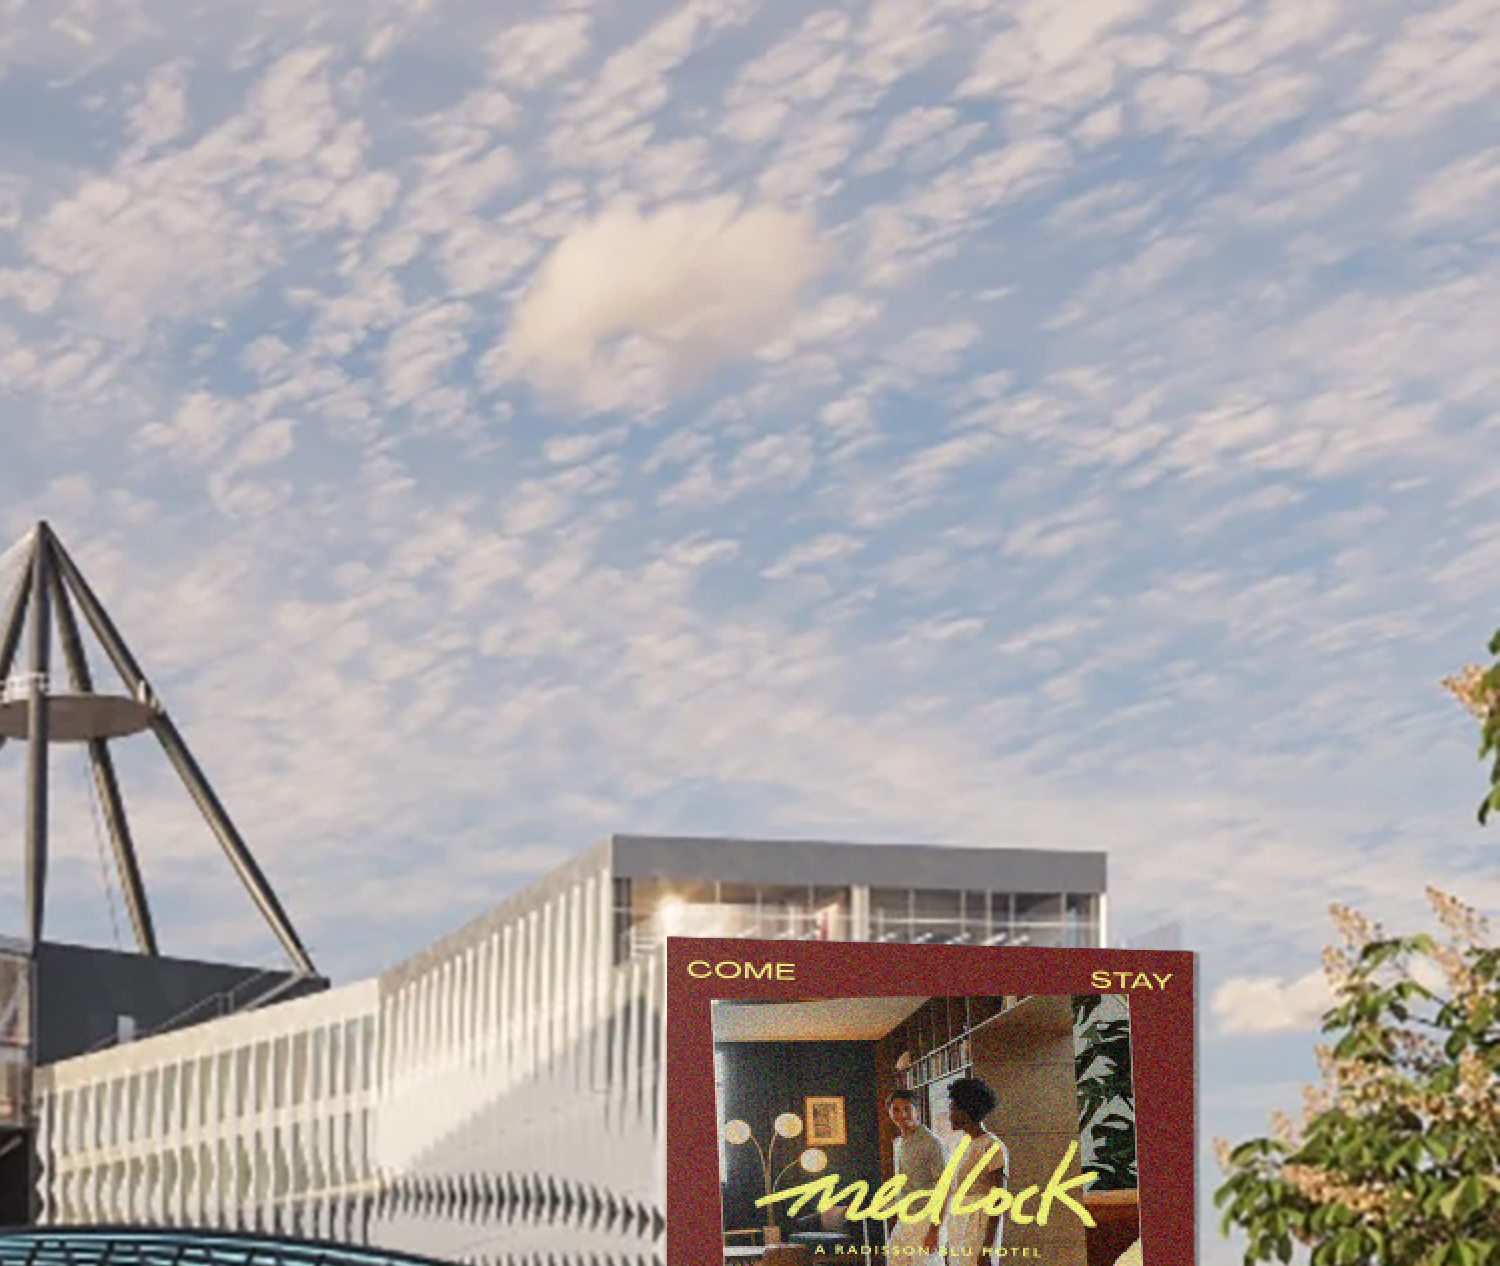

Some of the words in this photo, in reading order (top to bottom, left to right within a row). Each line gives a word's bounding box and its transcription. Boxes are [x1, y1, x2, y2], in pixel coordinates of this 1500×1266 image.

[687, 960, 797, 981] COME
[1091, 971, 1172, 990] STAY
[755, 1135, 1098, 1227] medlock
[814, 1244, 826, 1255] A
[835, 1244, 930, 1256] RADISSON
[939, 1246, 972, 1257] BLU
[983, 1247, 1042, 1259] HOTEL
